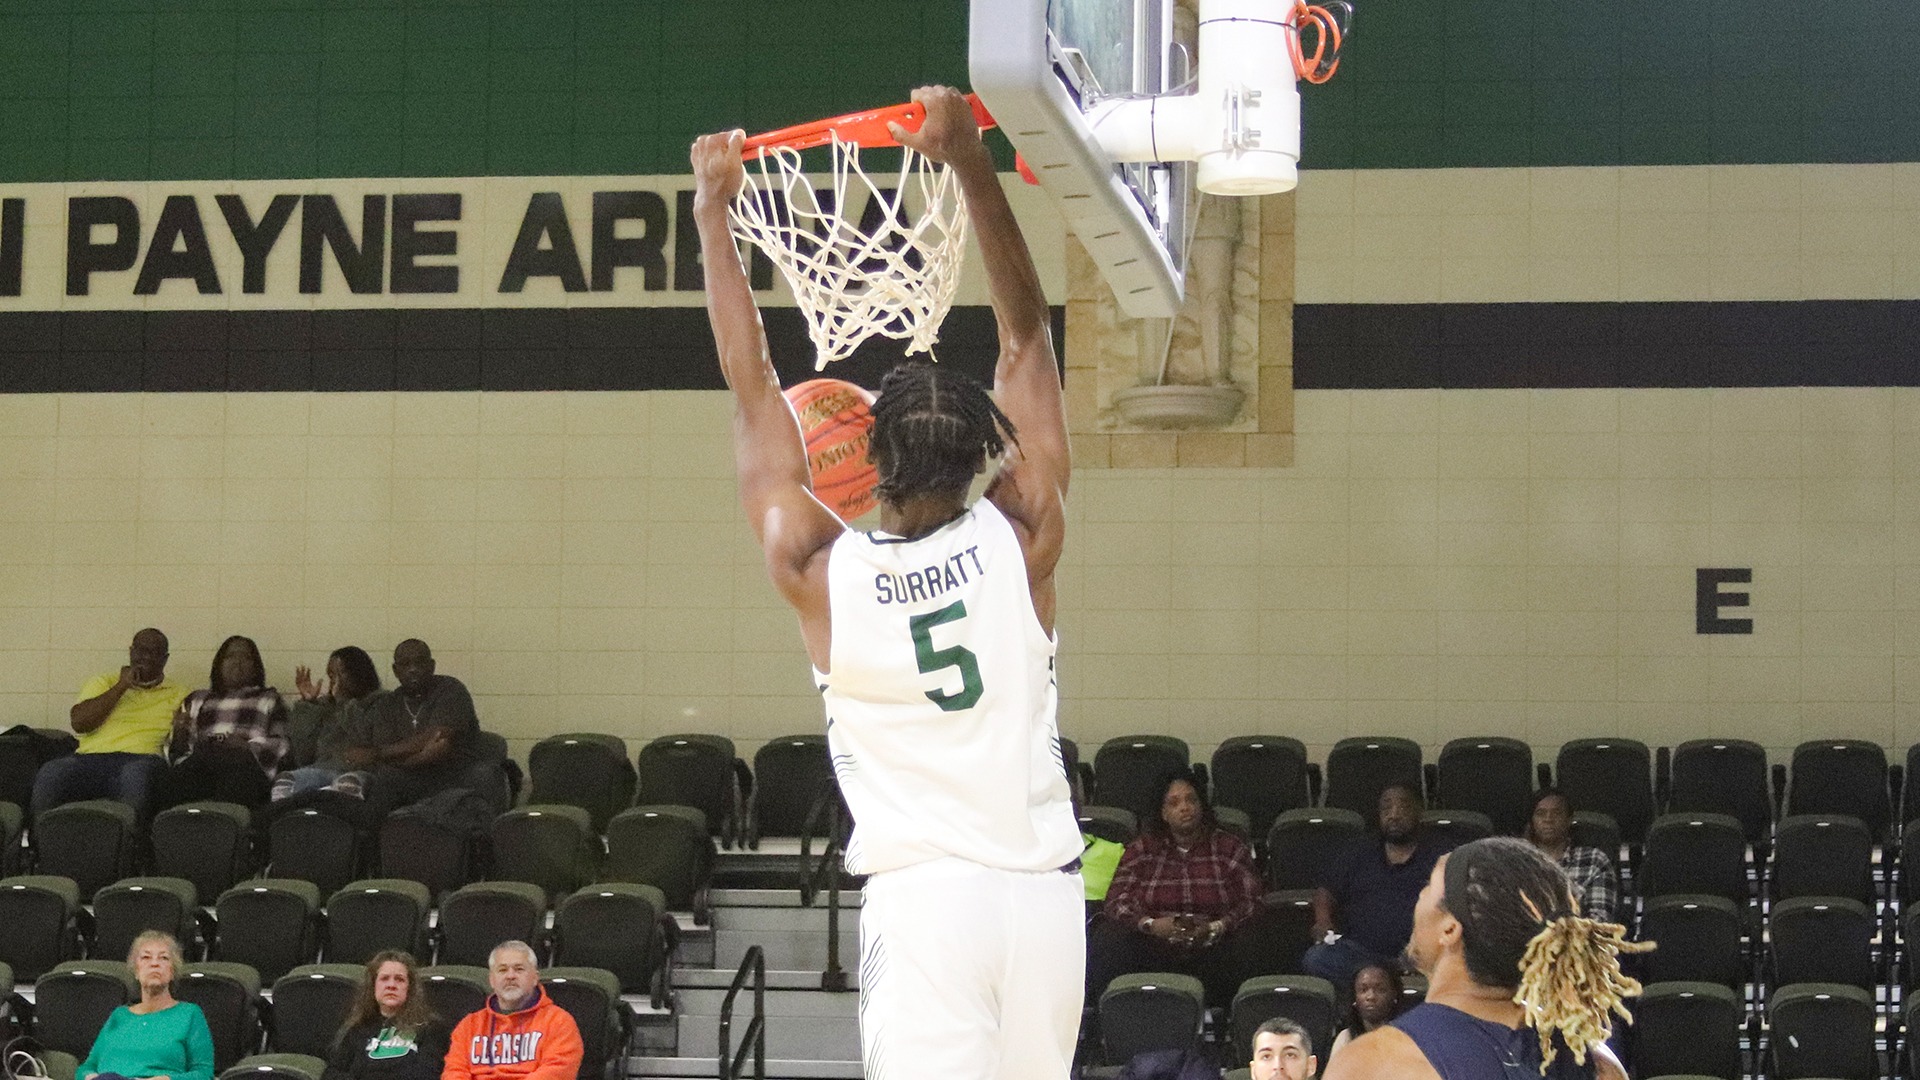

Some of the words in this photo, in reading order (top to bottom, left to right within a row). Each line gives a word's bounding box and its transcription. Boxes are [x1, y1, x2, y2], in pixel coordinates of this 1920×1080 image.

[66, 194, 462, 296] PAYNE
[874, 544, 985, 605] SURRATT
[1696, 568, 1753, 634] E
[909, 599, 985, 712] 5
[471, 1030, 543, 1066] CLEMSON
